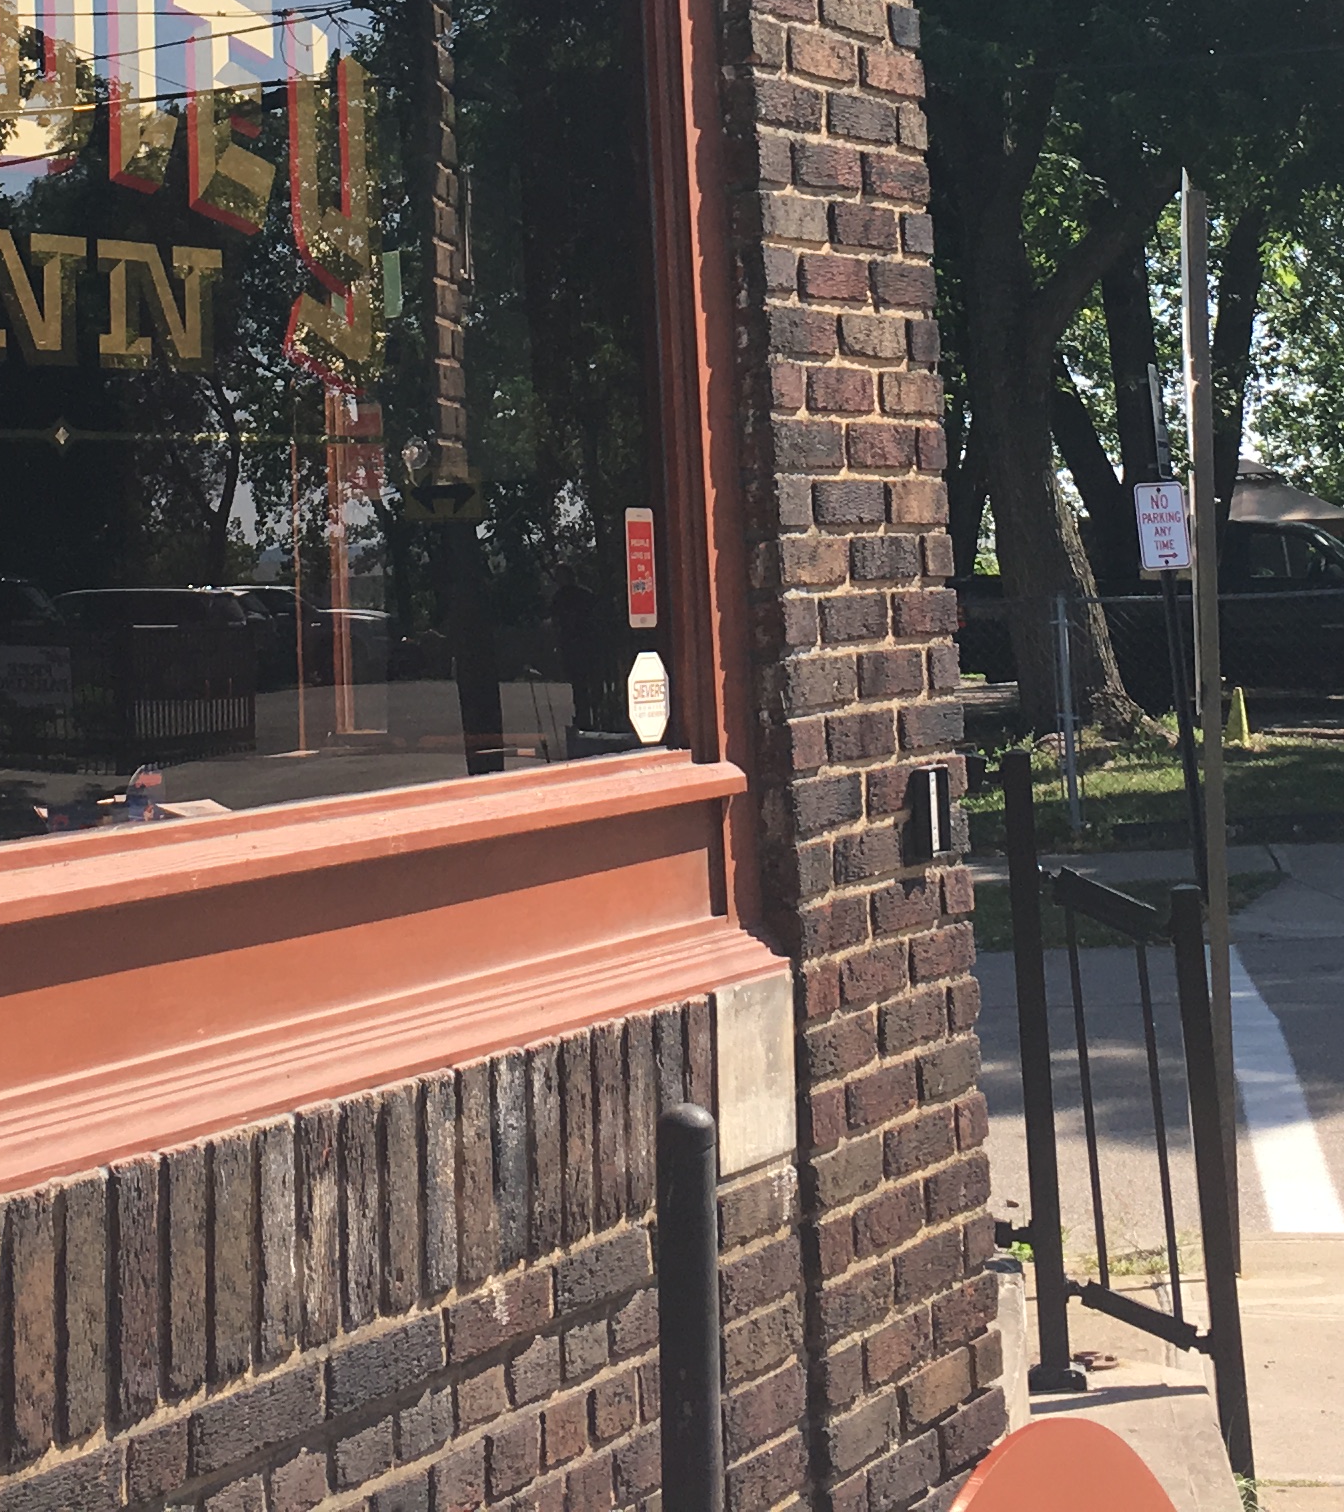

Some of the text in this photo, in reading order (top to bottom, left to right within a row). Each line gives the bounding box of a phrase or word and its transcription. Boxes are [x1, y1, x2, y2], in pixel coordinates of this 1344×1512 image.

[1150, 494, 1169, 509] NO
[1142, 511, 1181, 524] PARKING
[1154, 526, 1172, 537] ANY
[1154, 539, 1175, 550] TIME
